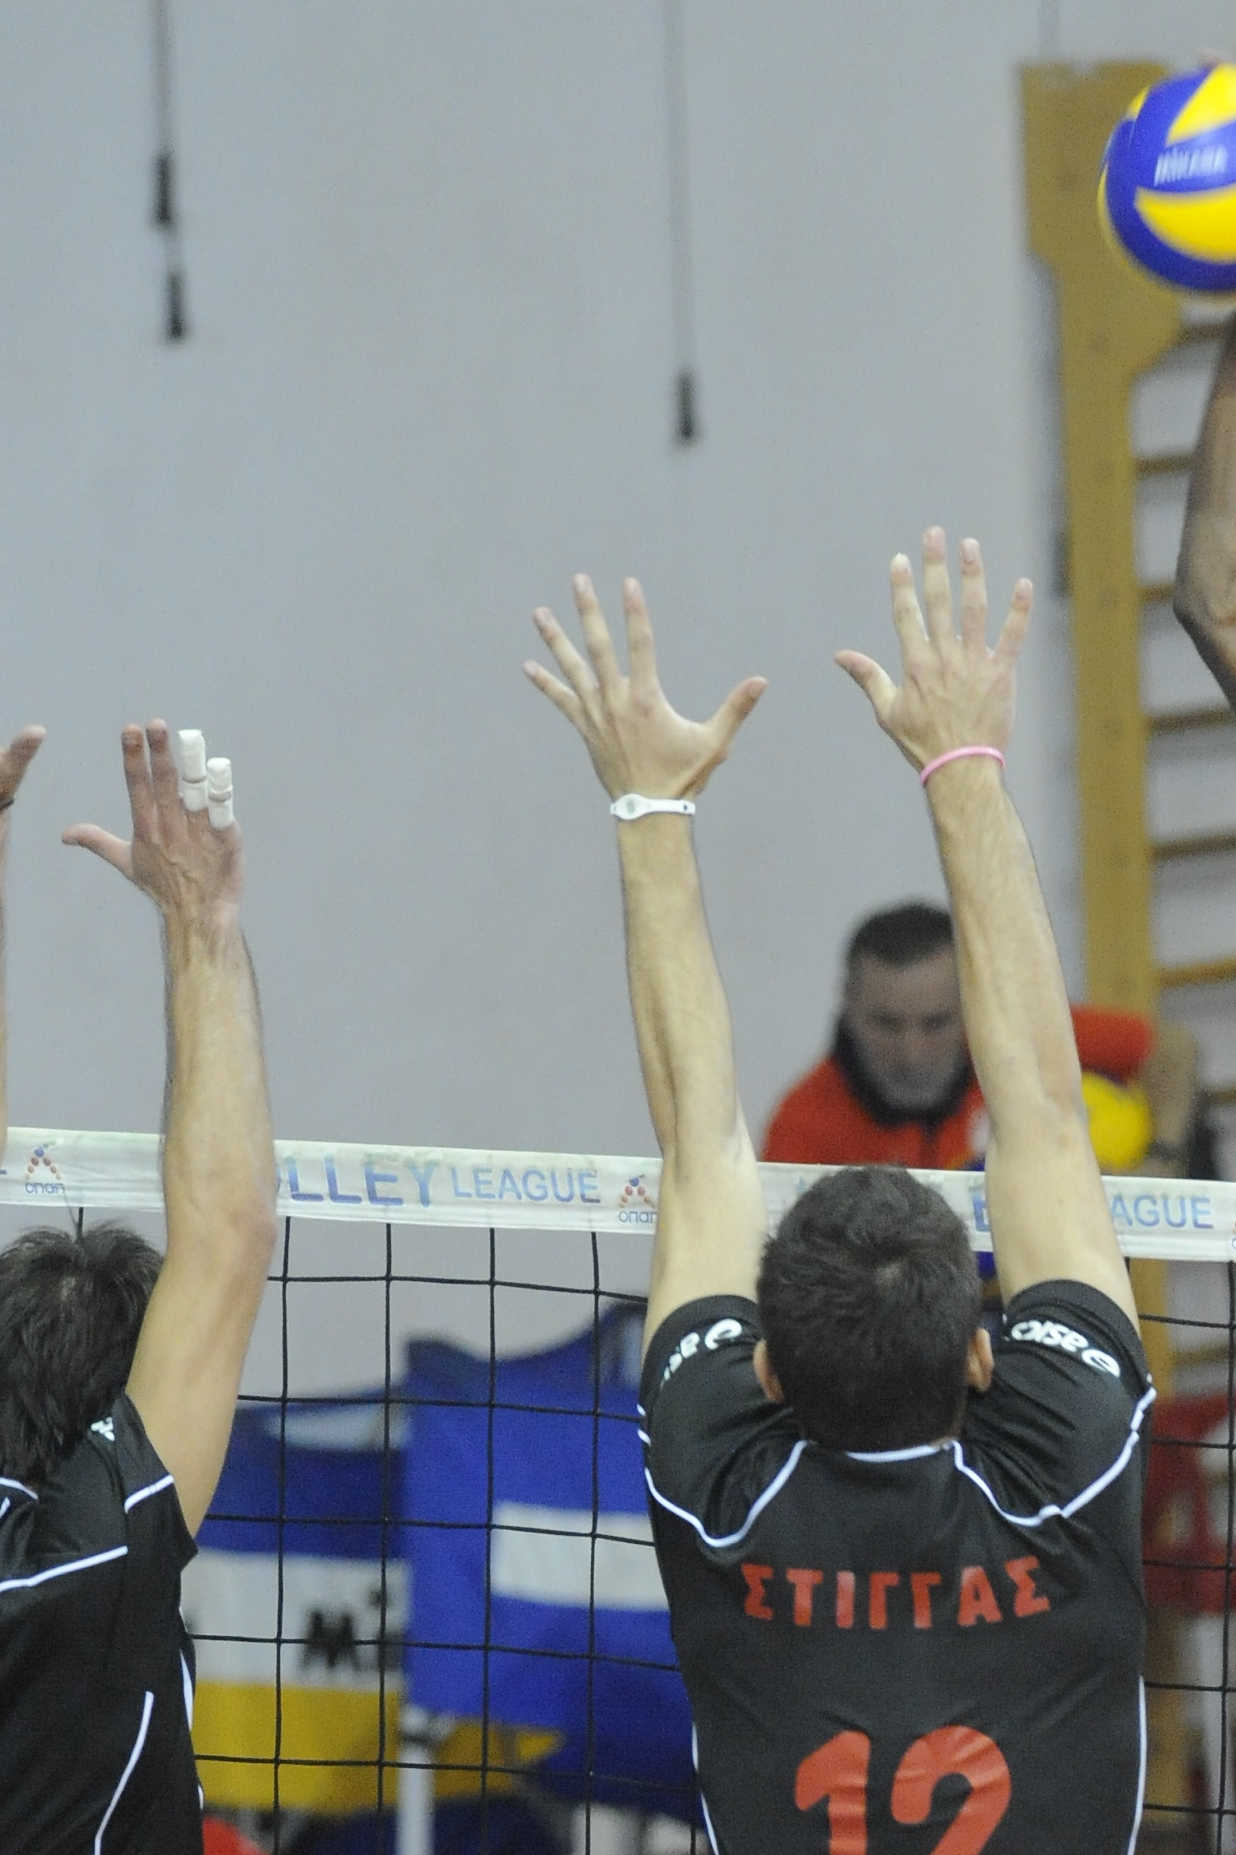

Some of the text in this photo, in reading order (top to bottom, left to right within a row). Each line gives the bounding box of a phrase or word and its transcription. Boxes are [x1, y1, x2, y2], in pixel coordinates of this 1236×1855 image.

[276, 1152, 602, 1208] LLEY LEAGUE
[1109, 1193, 1215, 1230] AGUE
[740, 1556, 1052, 1630] ΣΤΙΓΓΑΣ
